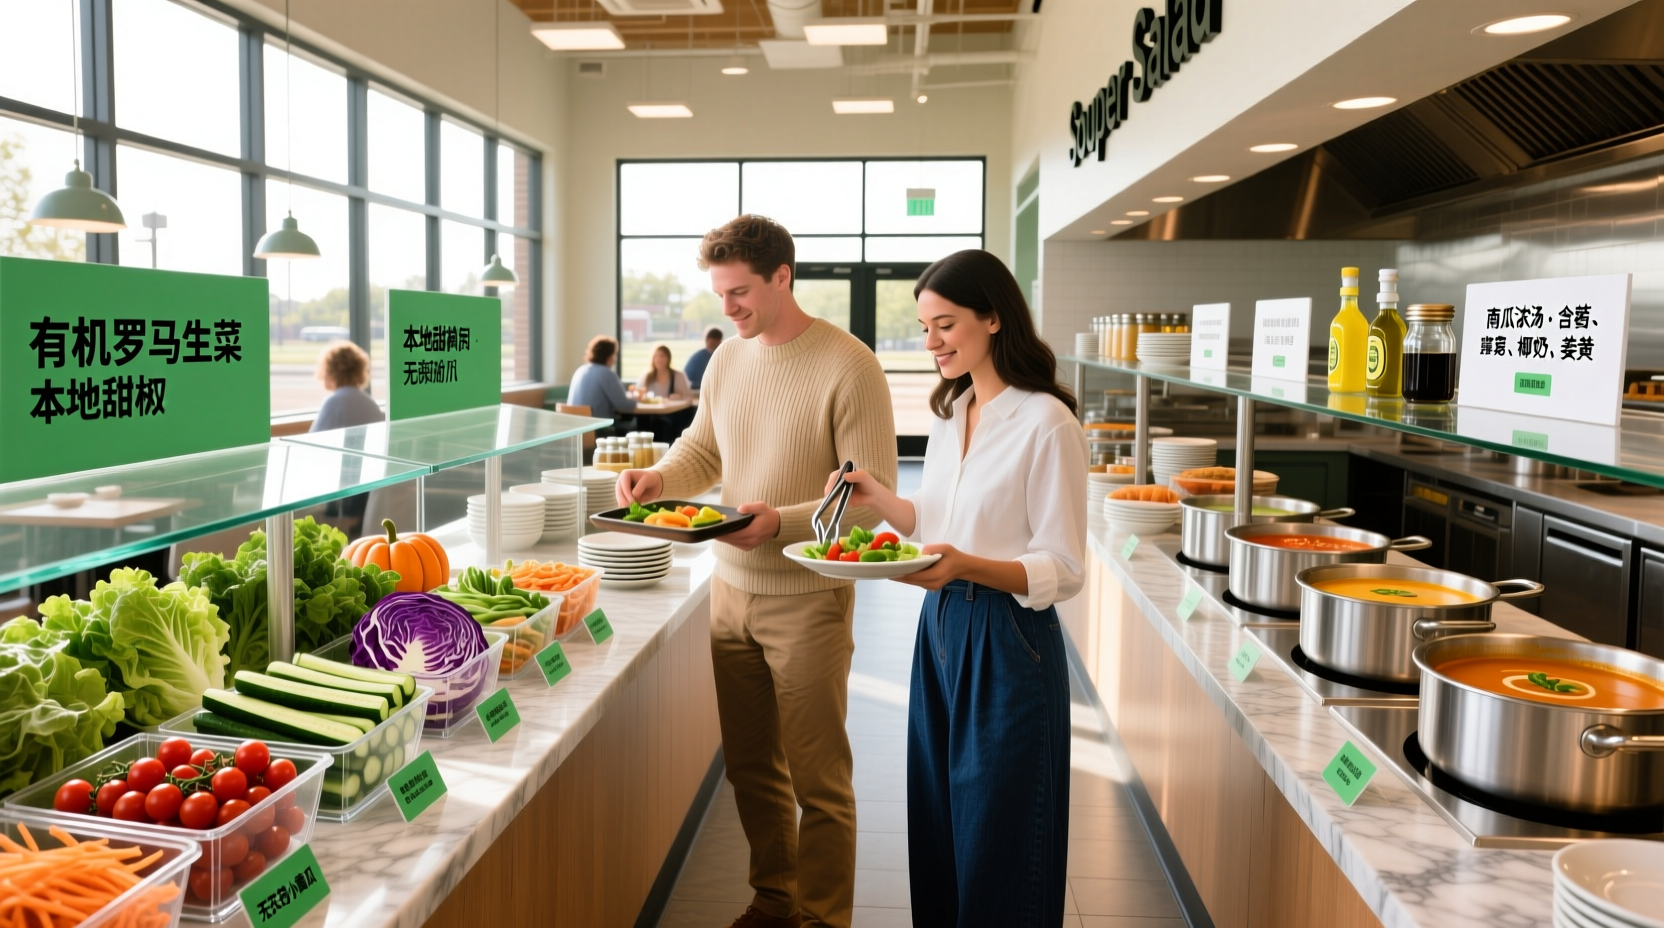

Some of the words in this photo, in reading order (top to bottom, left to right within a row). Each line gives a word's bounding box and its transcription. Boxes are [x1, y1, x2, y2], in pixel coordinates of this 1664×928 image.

[1069, 61, 1134, 168] Souper
[1132, 0, 1223, 103] Salad
[29, 316, 243, 369] 有机罗马生菜
